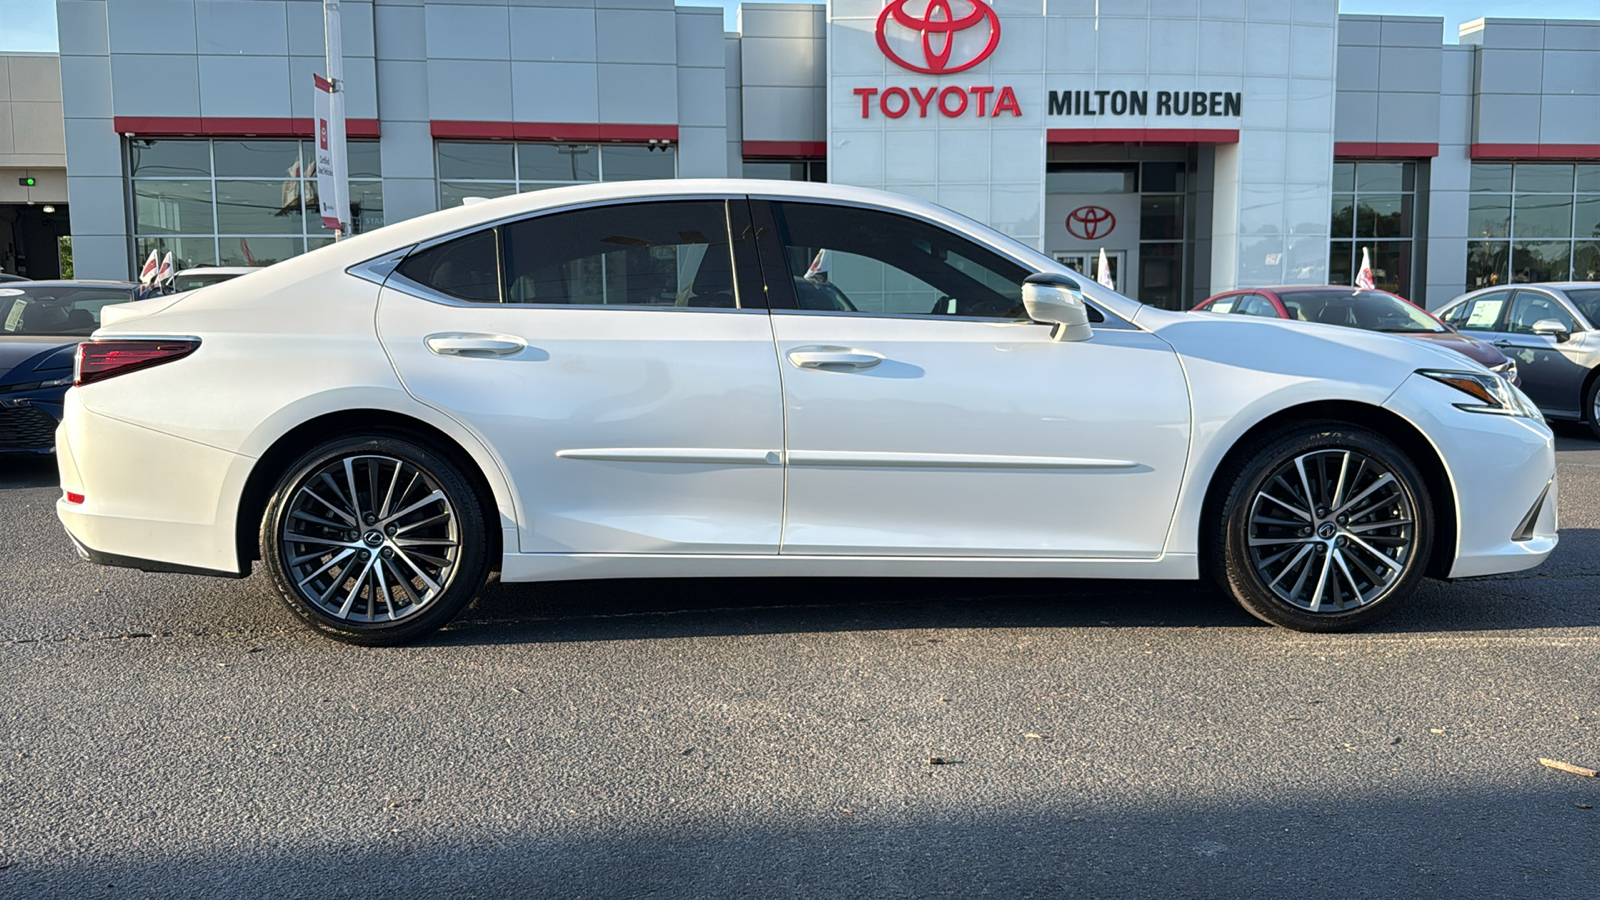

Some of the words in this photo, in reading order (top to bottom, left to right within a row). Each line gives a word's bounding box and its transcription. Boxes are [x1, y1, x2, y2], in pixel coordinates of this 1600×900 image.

[853, 86, 1022, 119] TOYOTA
[1048, 91, 1148, 116] MILTON
[1156, 91, 1242, 116] RUBEN
